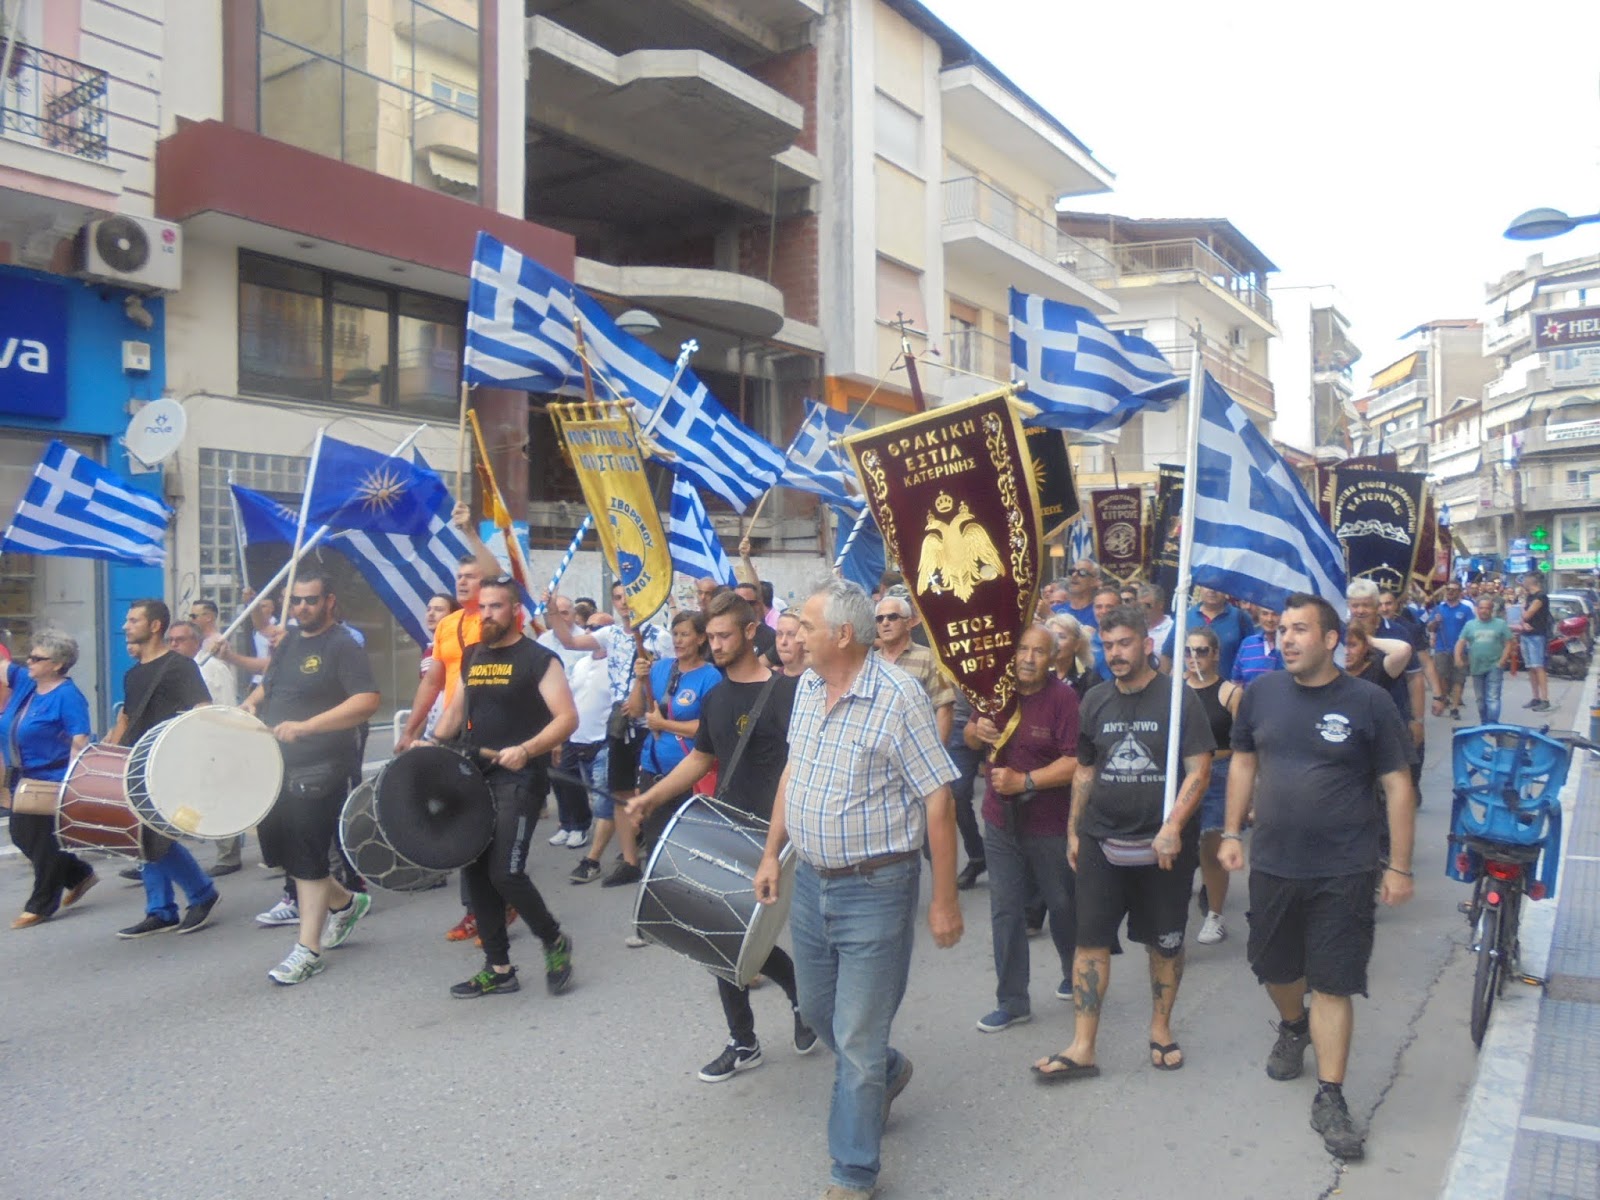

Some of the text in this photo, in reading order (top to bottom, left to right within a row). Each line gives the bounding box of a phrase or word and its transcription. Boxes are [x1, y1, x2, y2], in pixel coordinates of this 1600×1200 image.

[144, 425, 173, 434] nova
[887, 418, 976, 457] ΘΡΑΚΙΚΗ
[904, 444, 962, 472] ΕΣΤΙΑ
[903, 457, 977, 488] ΚΑΤΕΡΙΝΗΣ
[946, 614, 995, 637] ΕΤΟΣ
[960, 653, 996, 675] 1975
[1115, 774, 1138, 783] YOUR
